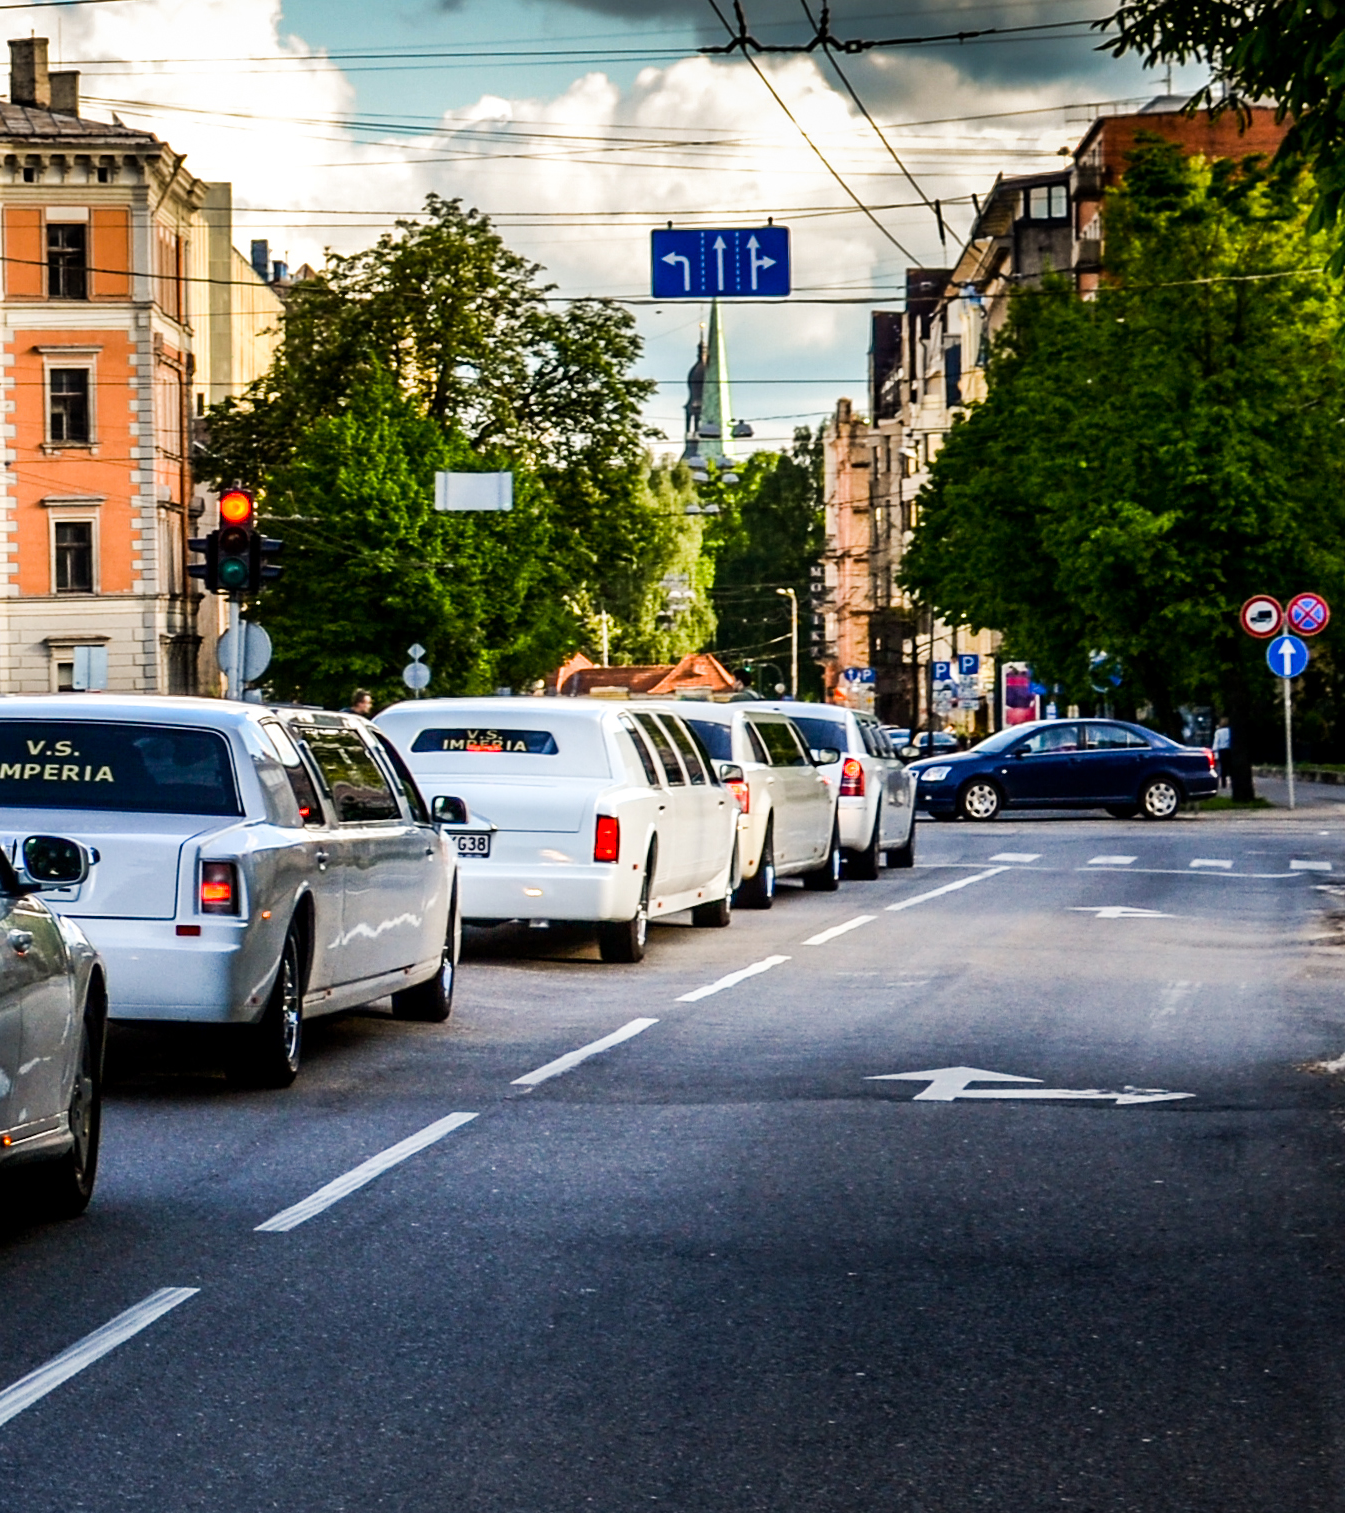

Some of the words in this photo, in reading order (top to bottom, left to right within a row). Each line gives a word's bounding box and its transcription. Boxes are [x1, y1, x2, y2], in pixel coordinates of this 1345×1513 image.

[935, 663, 948, 679] P
[962, 656, 975, 673] P
[467, 729, 503, 740] V.S.
[26, 740, 80, 757] V.S.
[452, 836, 486, 851] G38
